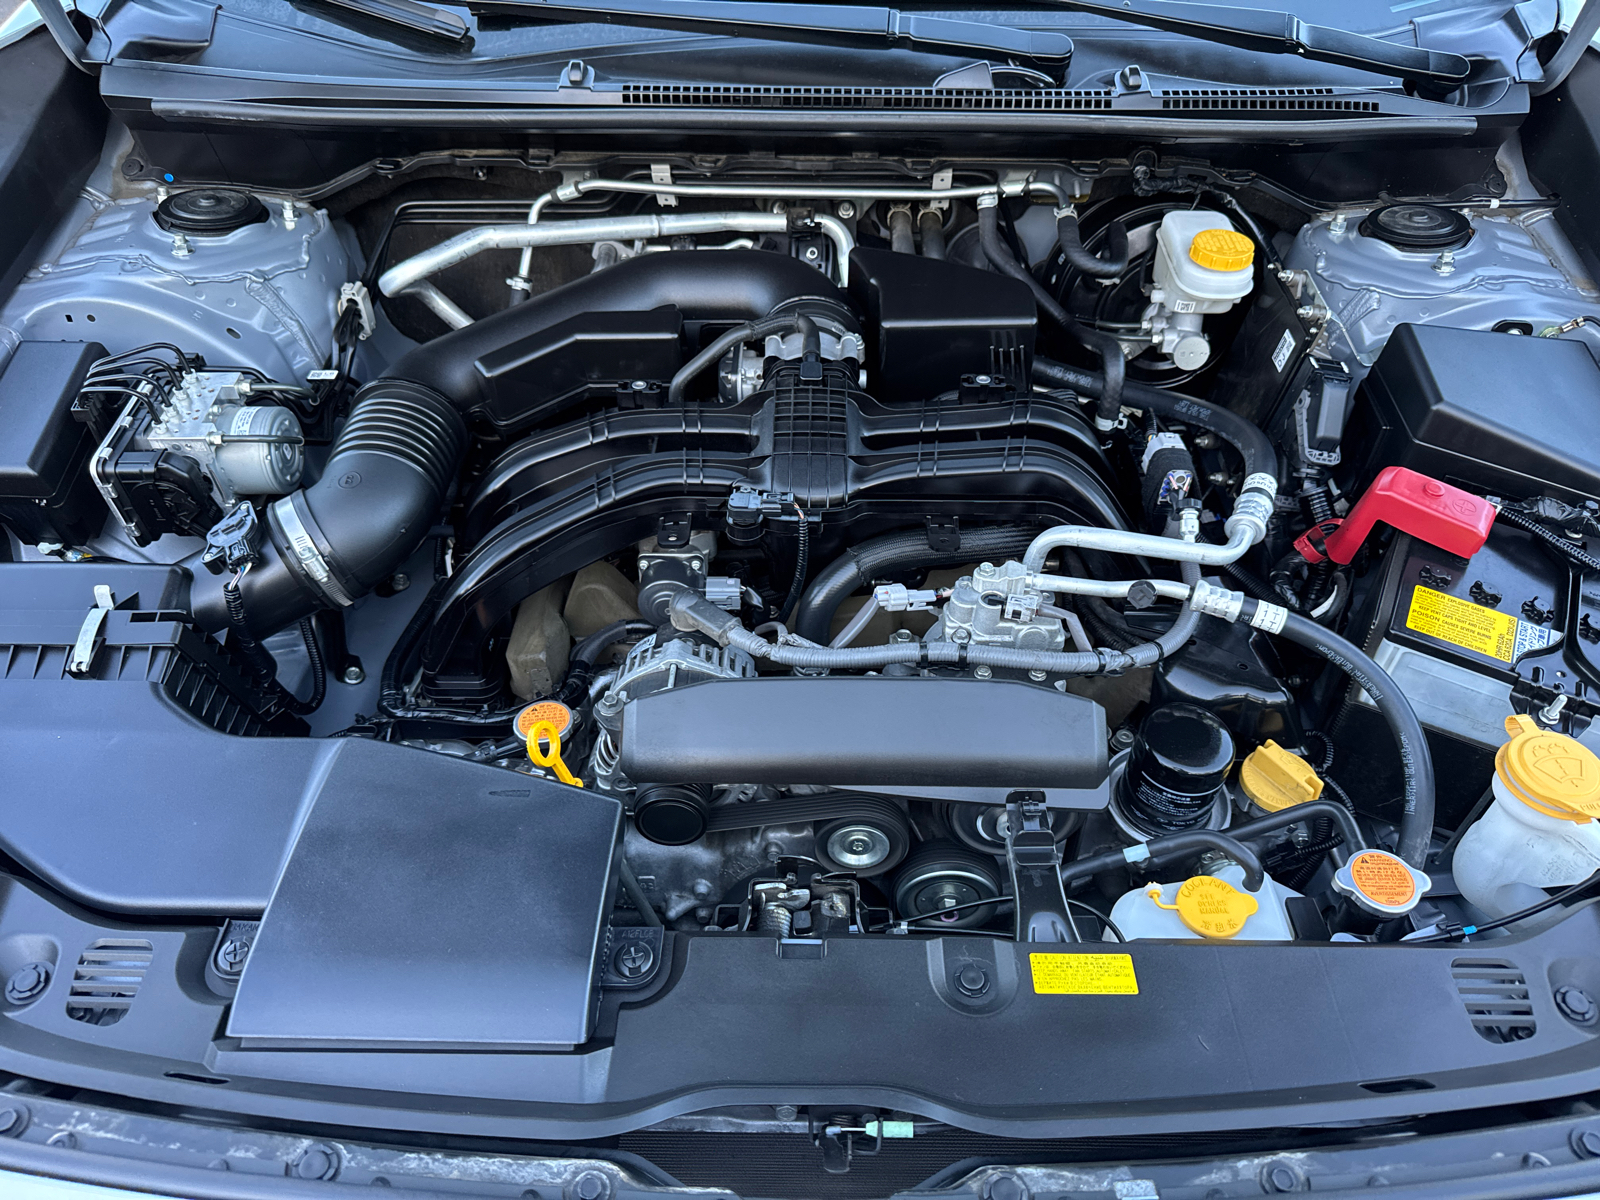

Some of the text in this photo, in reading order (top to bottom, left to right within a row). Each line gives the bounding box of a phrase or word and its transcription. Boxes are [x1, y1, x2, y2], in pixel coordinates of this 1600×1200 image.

[1417, 587, 1485, 614] DANGER EXPLOSIVE GASES
[1412, 608, 1492, 640] POISON CAUSES SEVERE BURNS
[1442, 612, 1454, 620] CAPS
[1454, 617, 1468, 625] TIGHT
[1478, 625, 1492, 633] LEVEL
[1518, 621, 1529, 637] START
[1442, 634, 1457, 643] REACH
[1464, 641, 1488, 653] CHILDREN
[1181, 877, 1236, 898] COOLANT
